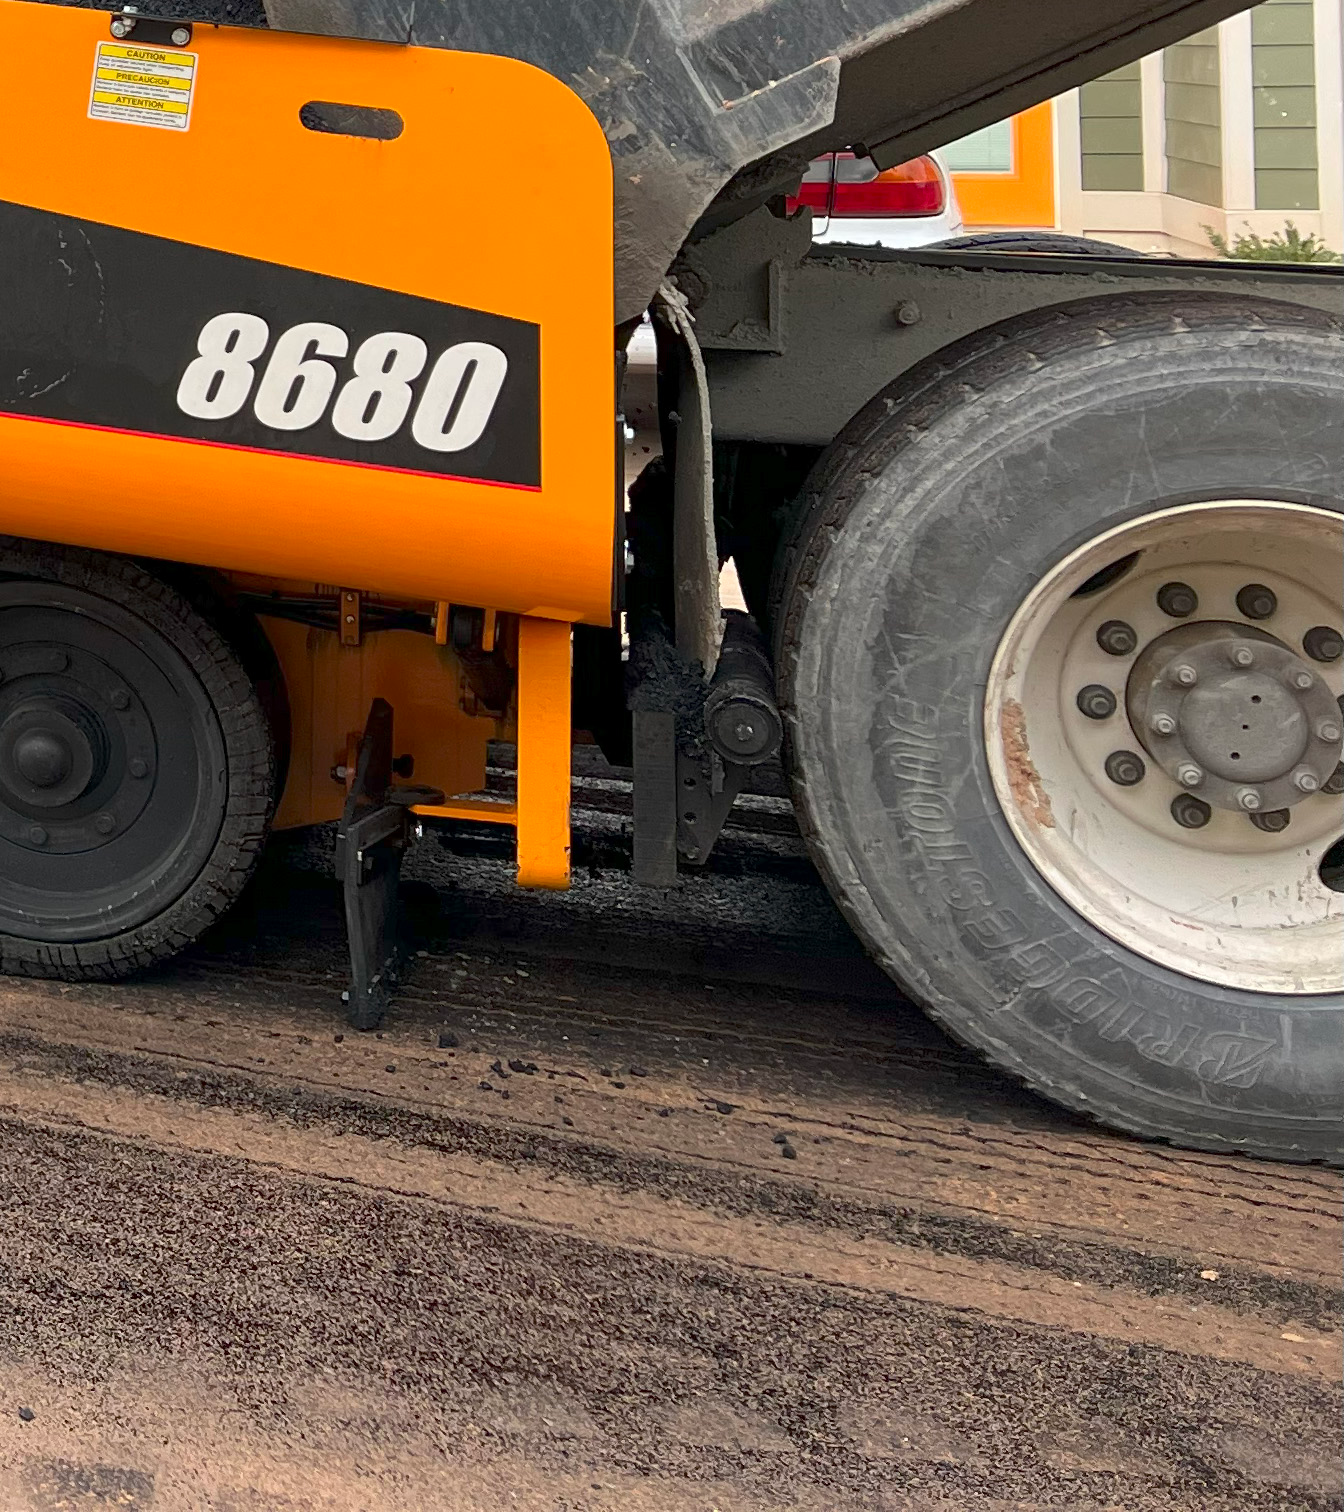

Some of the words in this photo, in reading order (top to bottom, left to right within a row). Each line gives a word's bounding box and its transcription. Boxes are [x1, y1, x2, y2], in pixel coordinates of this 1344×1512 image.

[126, 50, 166, 61] CAUTION
[115, 96, 164, 109] ATTENTION
[176, 312, 508, 453] 8680
